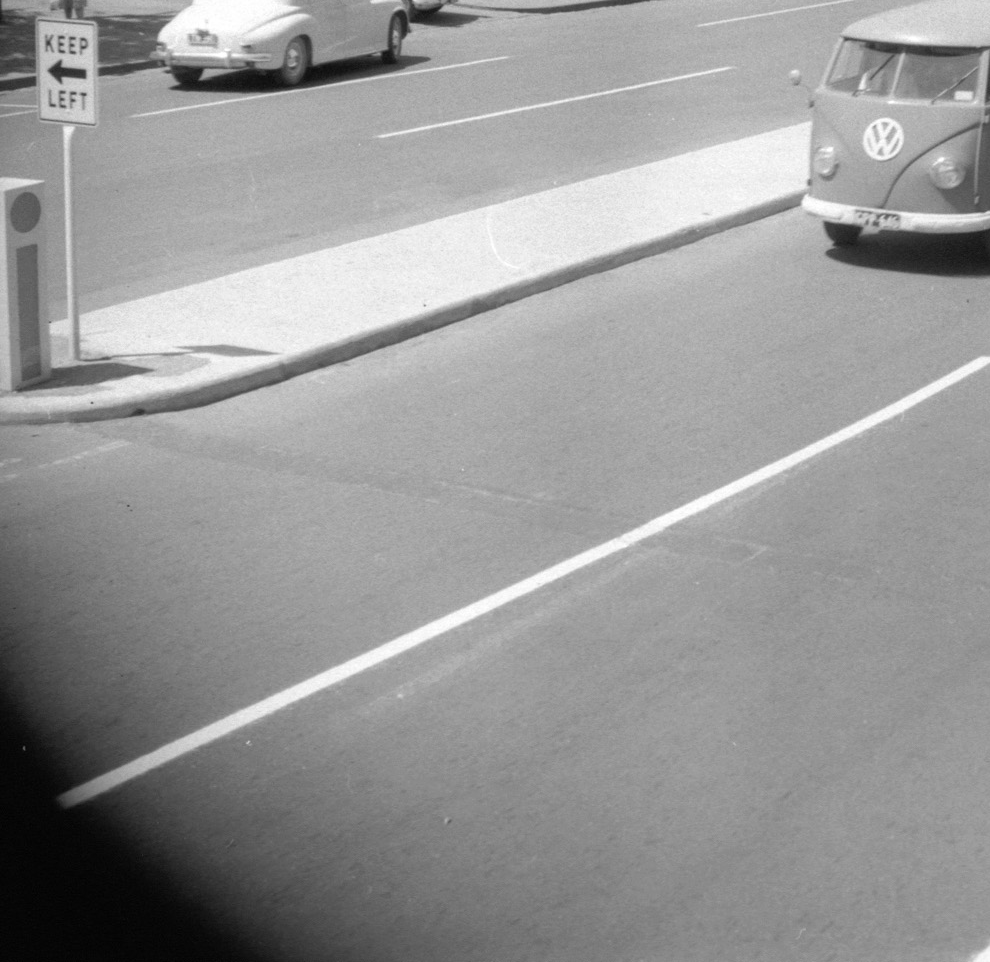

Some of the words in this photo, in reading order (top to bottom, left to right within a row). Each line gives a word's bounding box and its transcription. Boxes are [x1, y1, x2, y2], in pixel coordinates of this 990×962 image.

[44, 34, 89, 55] KEEP
[47, 89, 88, 110] LEFT
[863, 118, 904, 161] VW
